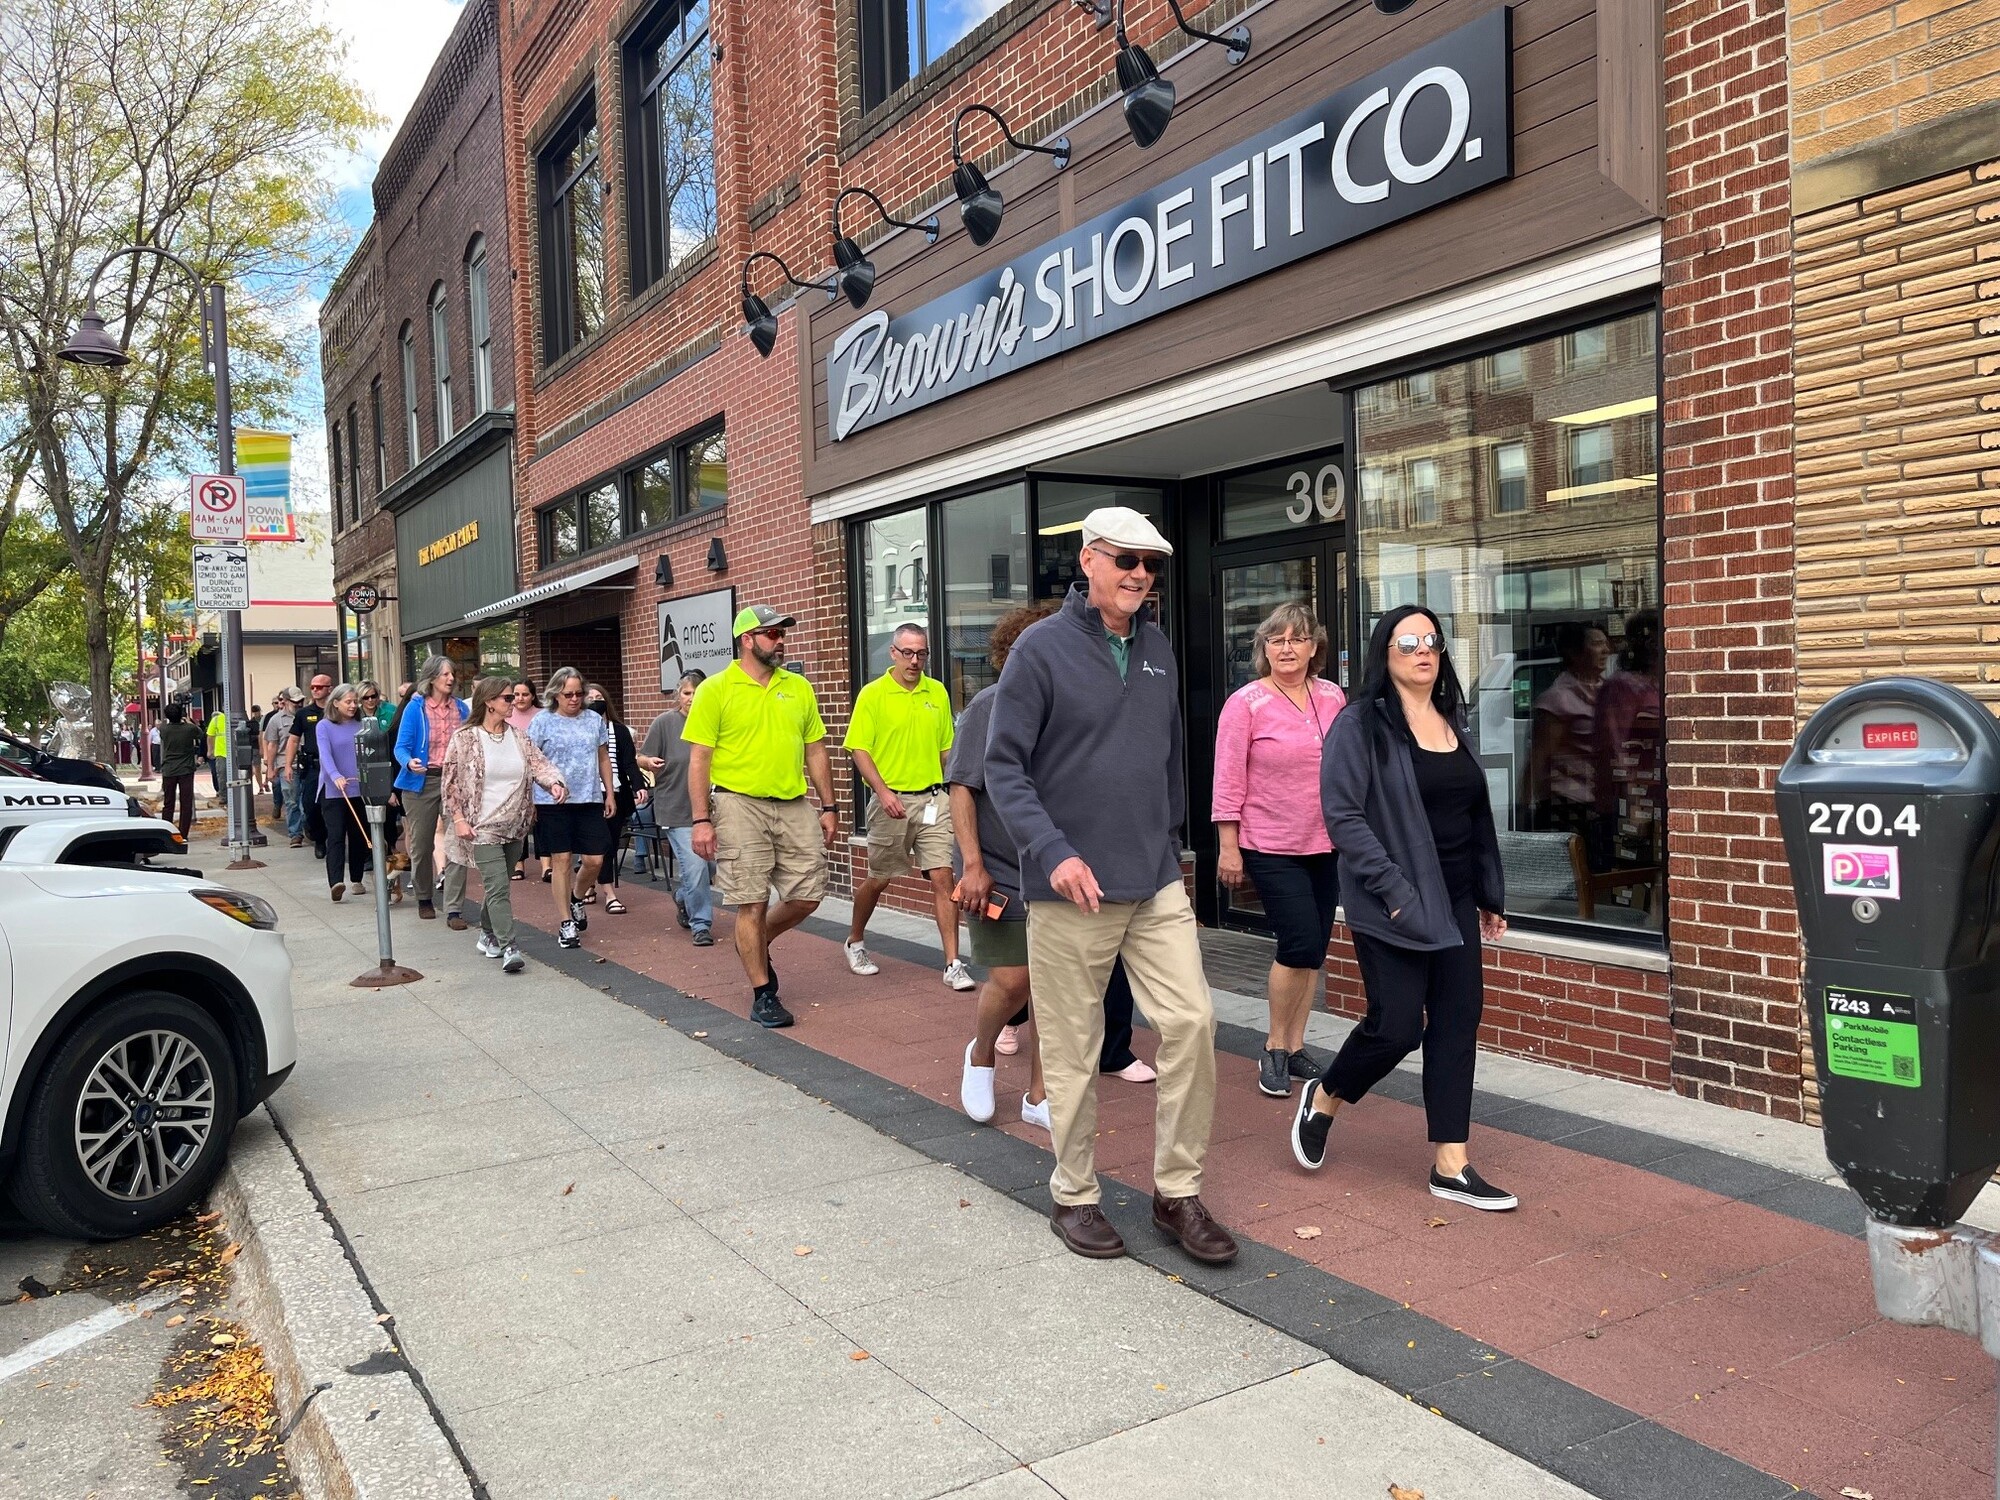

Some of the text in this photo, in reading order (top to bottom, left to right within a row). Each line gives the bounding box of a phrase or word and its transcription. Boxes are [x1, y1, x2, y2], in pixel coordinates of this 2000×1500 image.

[833, 65, 1484, 441] Brown's SHOE FIT CO.
[1286, 463, 1345, 524] 30
[247, 505, 284, 517] DOWN
[249, 514, 285, 525] TOWN
[206, 525, 230, 535] DAILY
[230, 565, 245, 573] ZONE
[1867, 730, 1918, 744] EXPIRED
[3, 795, 111, 807] MOAB
[1808, 802, 1921, 837] 270.4
[1828, 997, 1870, 1015] 7243
[1843, 1021, 1890, 1035] ParkMobile
[1831, 1032, 1888, 1048] Contactless
[1832, 1041, 1868, 1056] Parking
